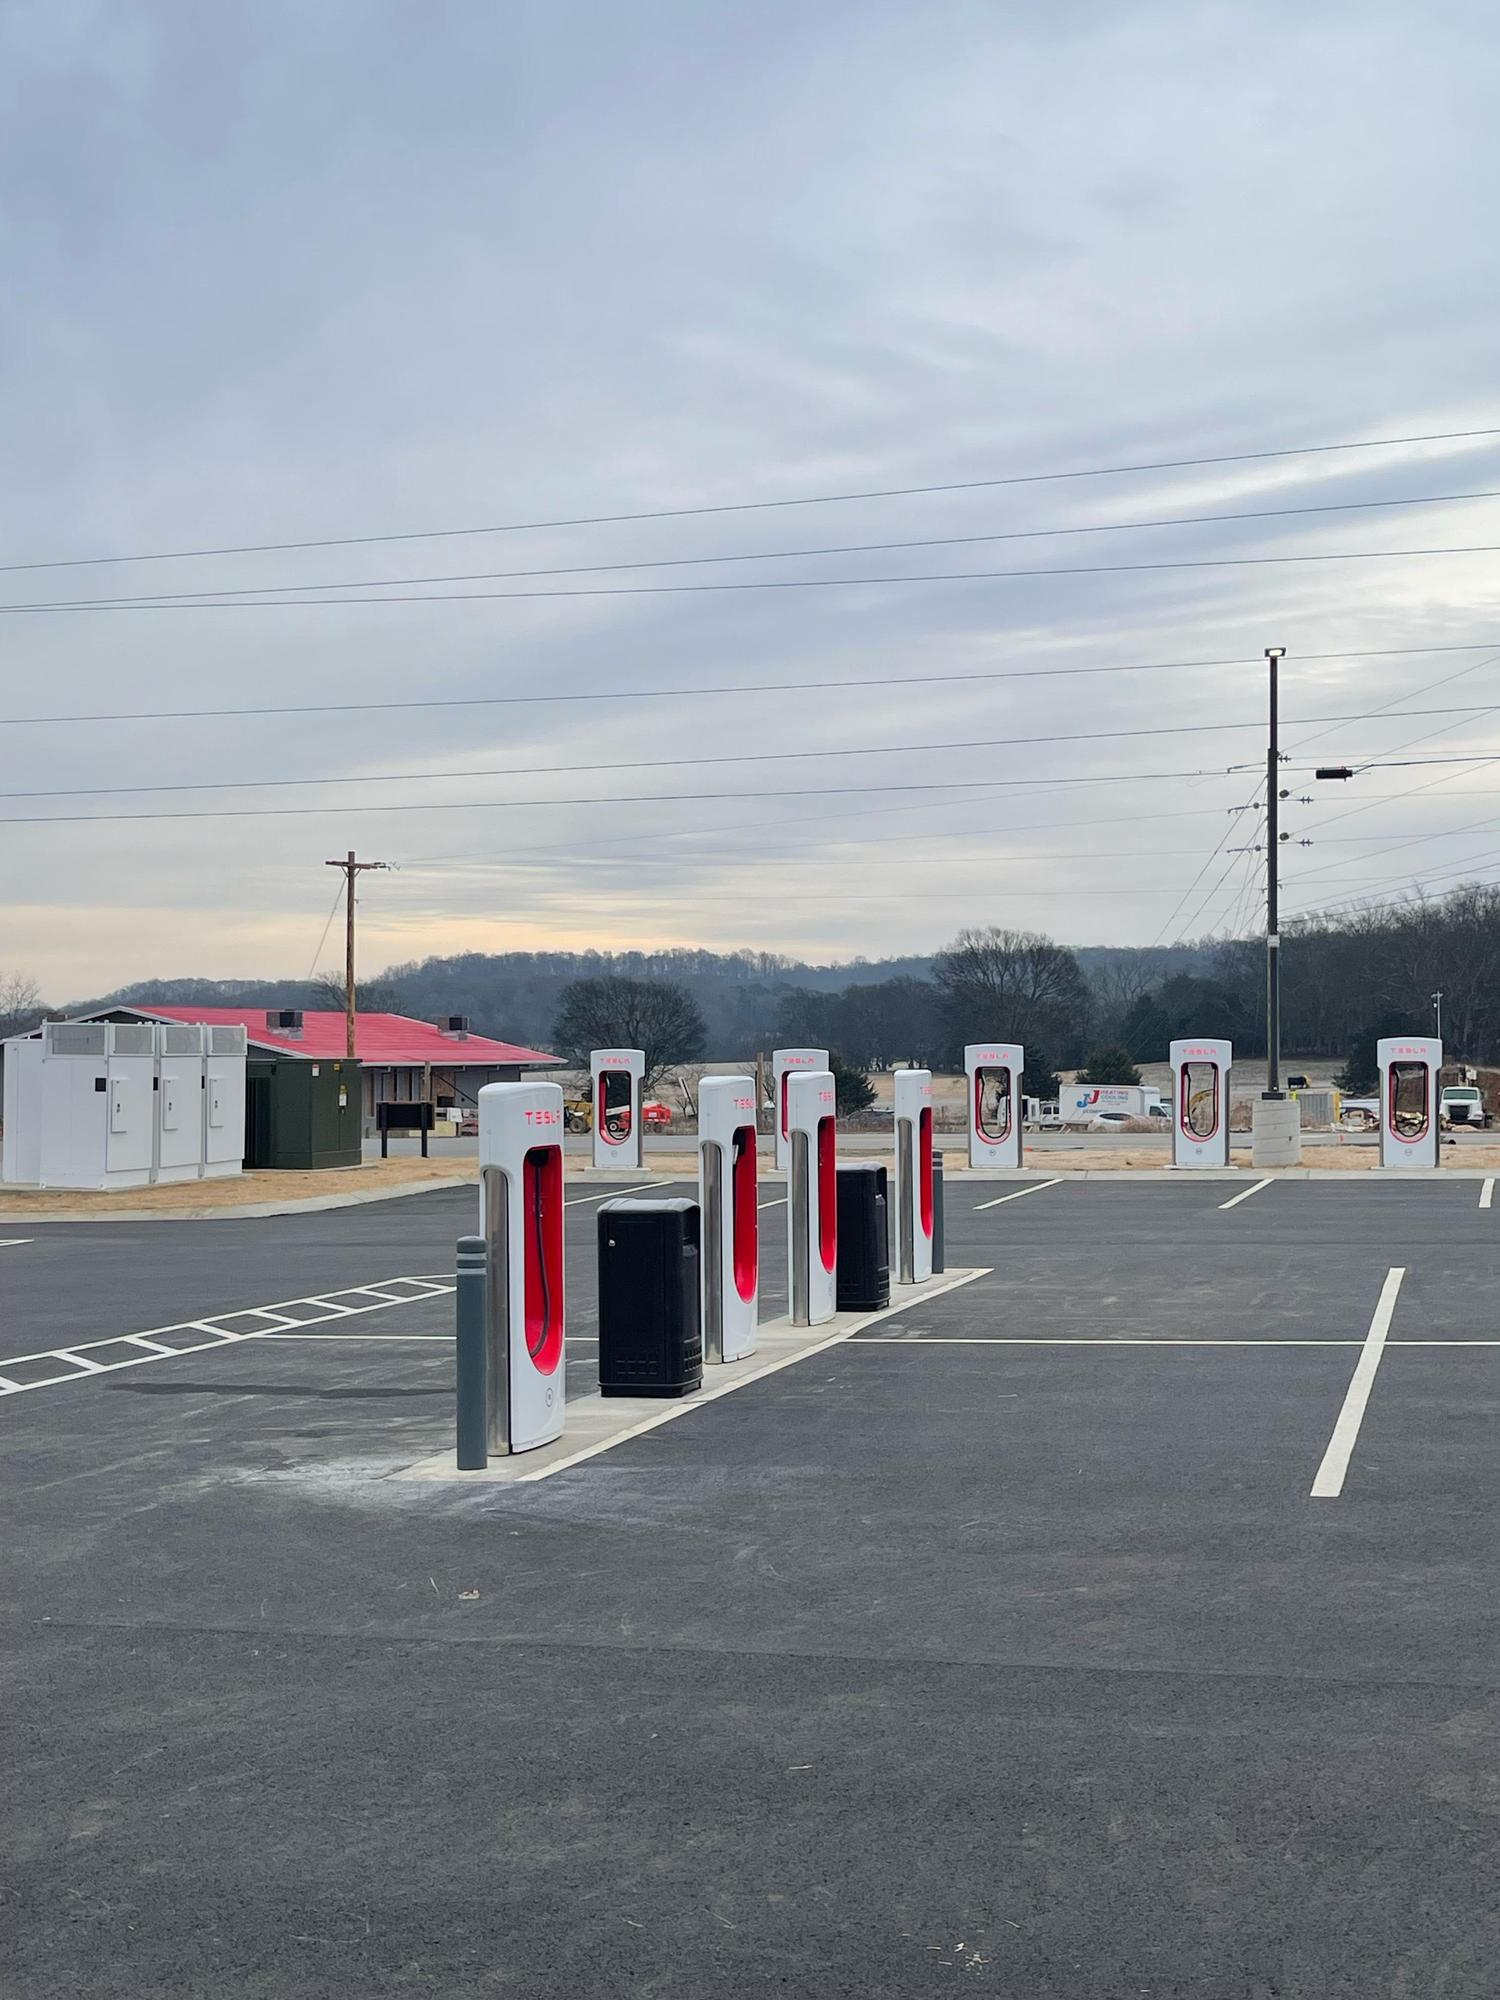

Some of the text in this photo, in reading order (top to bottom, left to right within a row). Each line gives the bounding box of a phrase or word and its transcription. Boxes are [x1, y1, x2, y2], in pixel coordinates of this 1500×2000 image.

[1183, 1048, 1216, 1056] TESLA
[1390, 1047, 1426, 1055] TESLA
[976, 1052, 1008, 1060] TESLA
[600, 1057, 631, 1065] TESLA
[783, 1057, 815, 1065] TESLA
